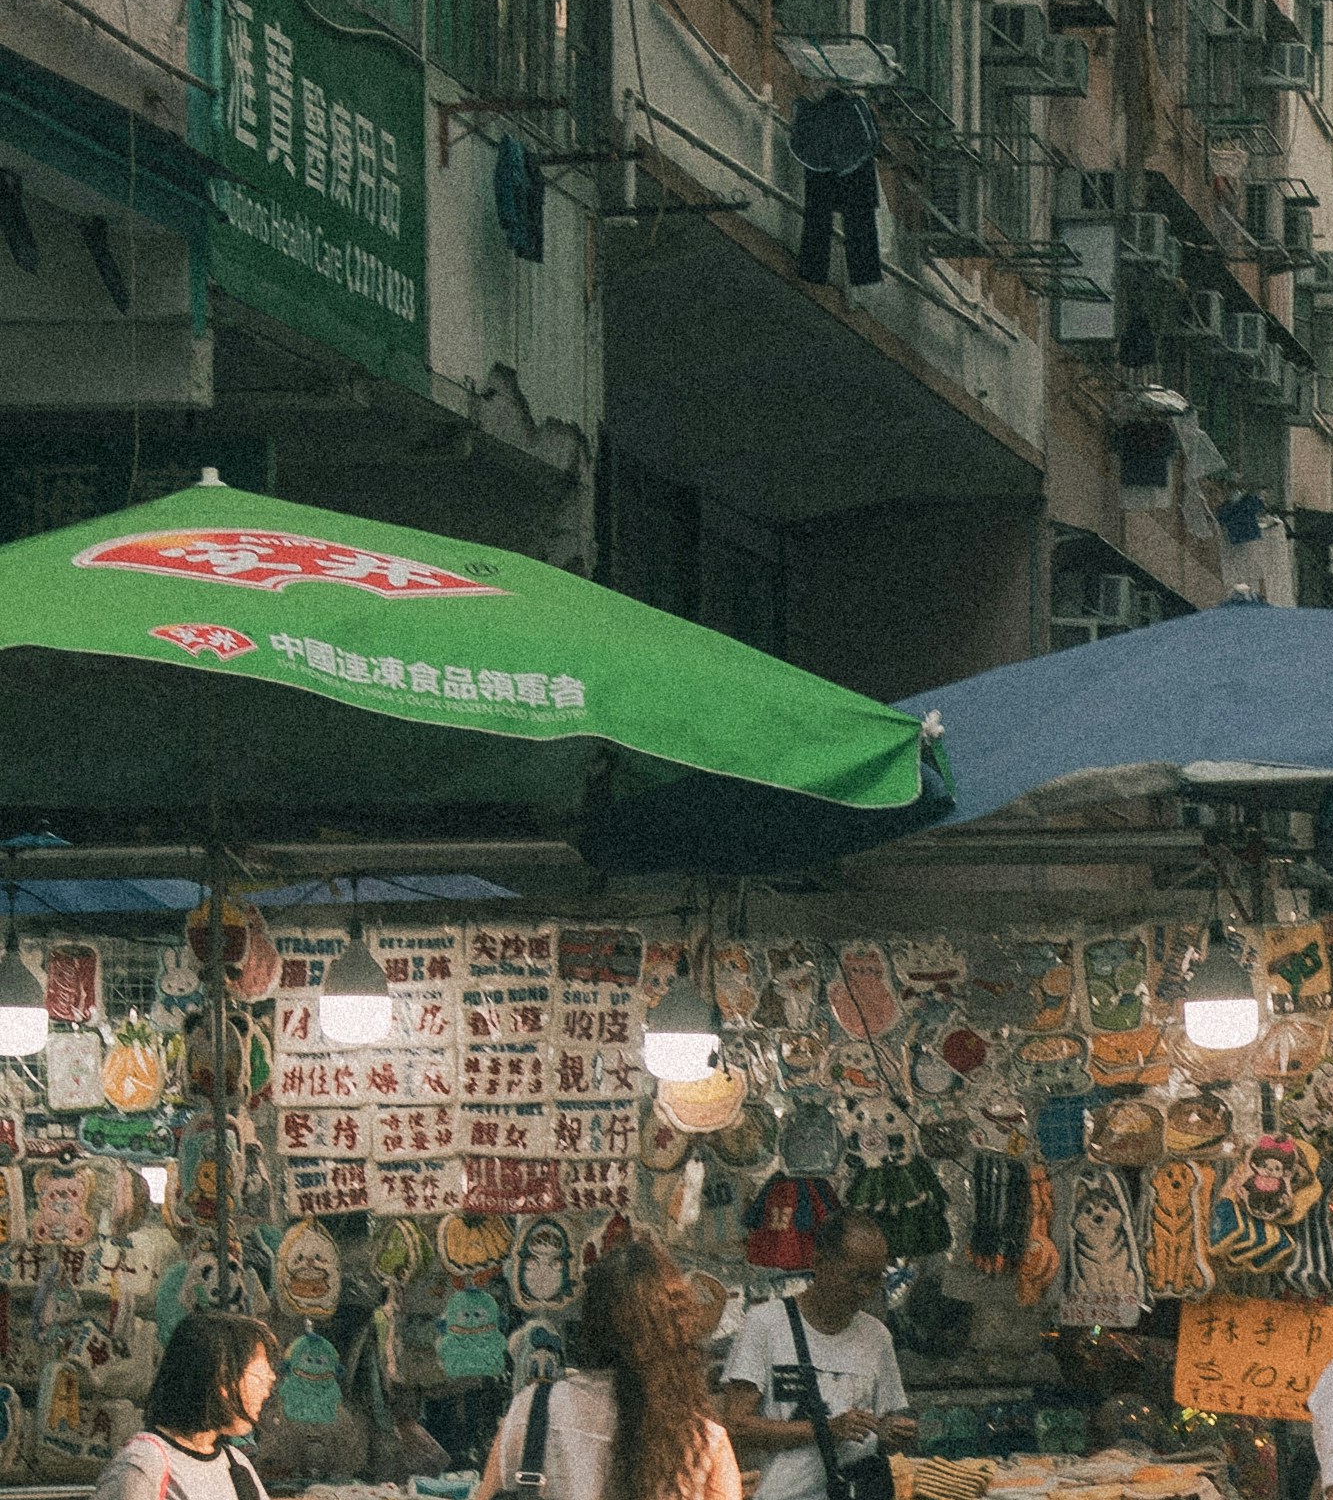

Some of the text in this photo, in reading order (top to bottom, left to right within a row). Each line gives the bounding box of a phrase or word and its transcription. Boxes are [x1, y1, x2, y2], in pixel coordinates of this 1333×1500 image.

[269, 632, 586, 710] 中國速凍食品領軍者
